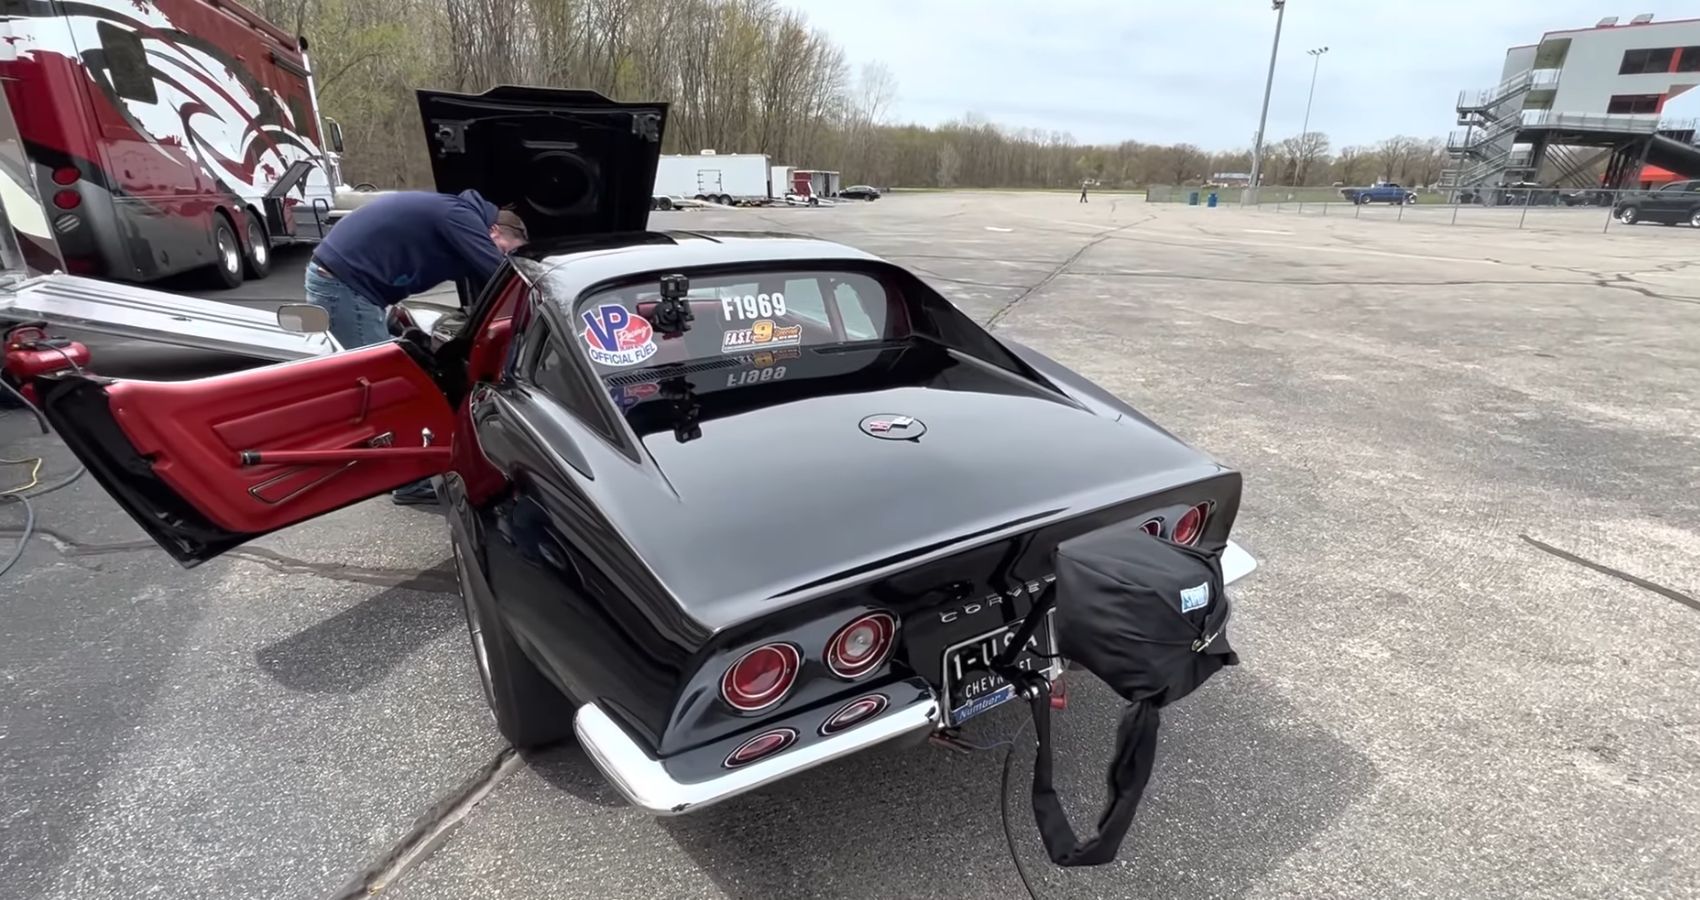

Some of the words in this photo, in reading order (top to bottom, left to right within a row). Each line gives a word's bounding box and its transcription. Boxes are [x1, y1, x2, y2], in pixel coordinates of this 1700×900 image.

[721, 293, 786, 320] F1969
[582, 305, 629, 352] VP
[753, 321, 774, 344] 9
[591, 349, 634, 364] OFFICIAL
[635, 343, 655, 361] FUEL
[959, 694, 1002, 719] Number
